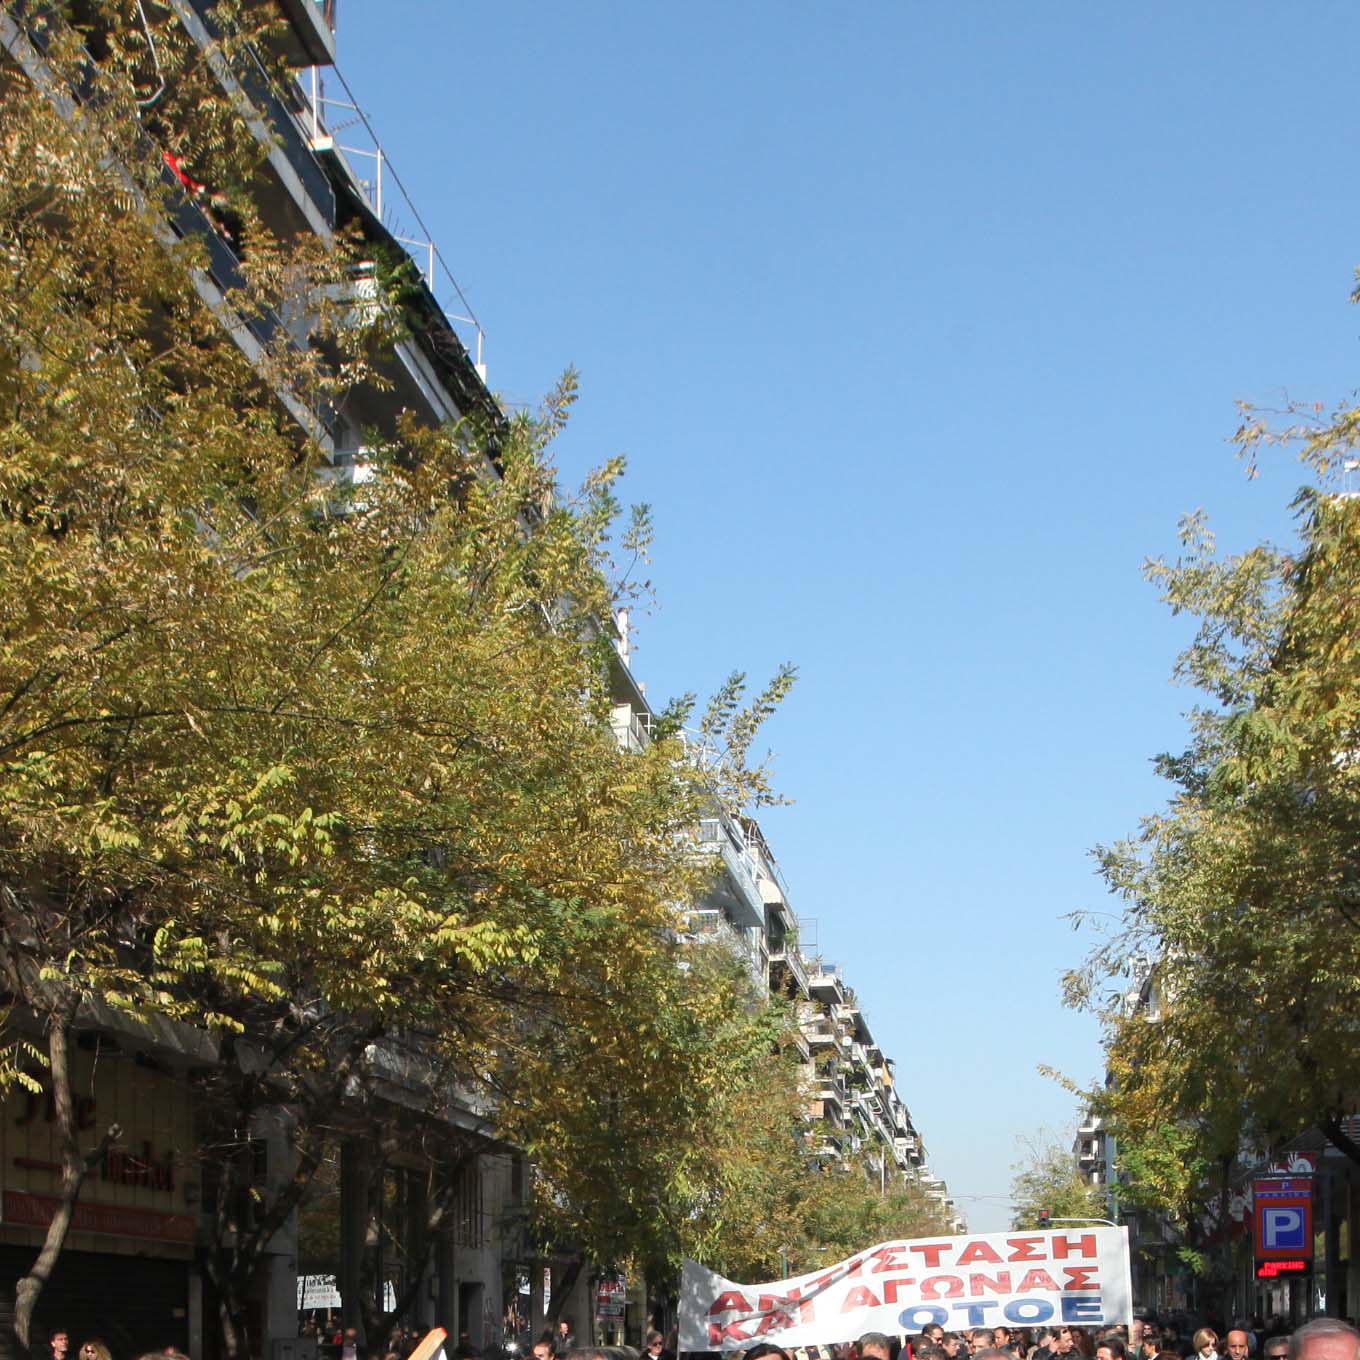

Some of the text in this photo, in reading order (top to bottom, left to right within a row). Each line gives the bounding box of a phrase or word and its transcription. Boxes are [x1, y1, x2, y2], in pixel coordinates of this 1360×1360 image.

[1266, 1209, 1301, 1246] P
[705, 1234, 1097, 1318] ΑΝΤΙΣΤΑΣΗ
[1263, 1260, 1305, 1270] PARKING
[708, 1266, 1101, 1347] ΚΑΙ ΑΓΩΝΑΣ
[898, 1296, 1105, 1332] ΟΤΟΕ
